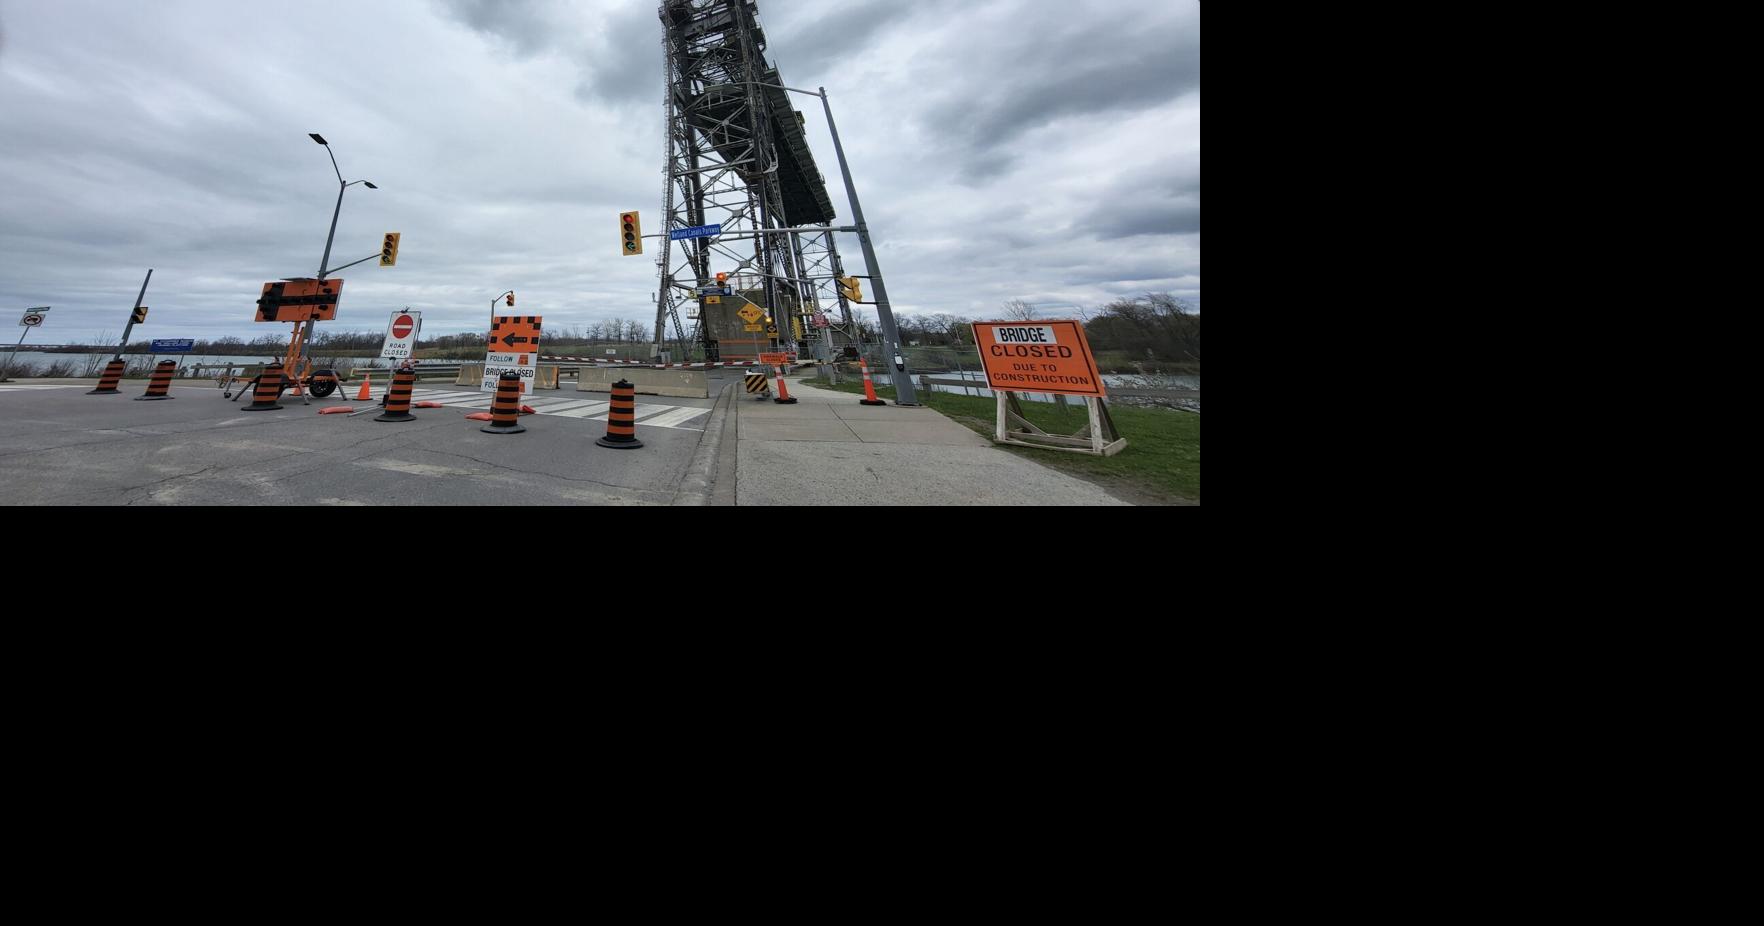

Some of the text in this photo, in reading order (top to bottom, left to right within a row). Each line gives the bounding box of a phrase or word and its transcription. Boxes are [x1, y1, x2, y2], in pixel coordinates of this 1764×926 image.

[999, 327, 1047, 342] BRIDGE
[991, 345, 1072, 358] CLOSED
[1013, 363, 1056, 372] DUE TO
[994, 373, 1088, 384] CONSTRUCTION
